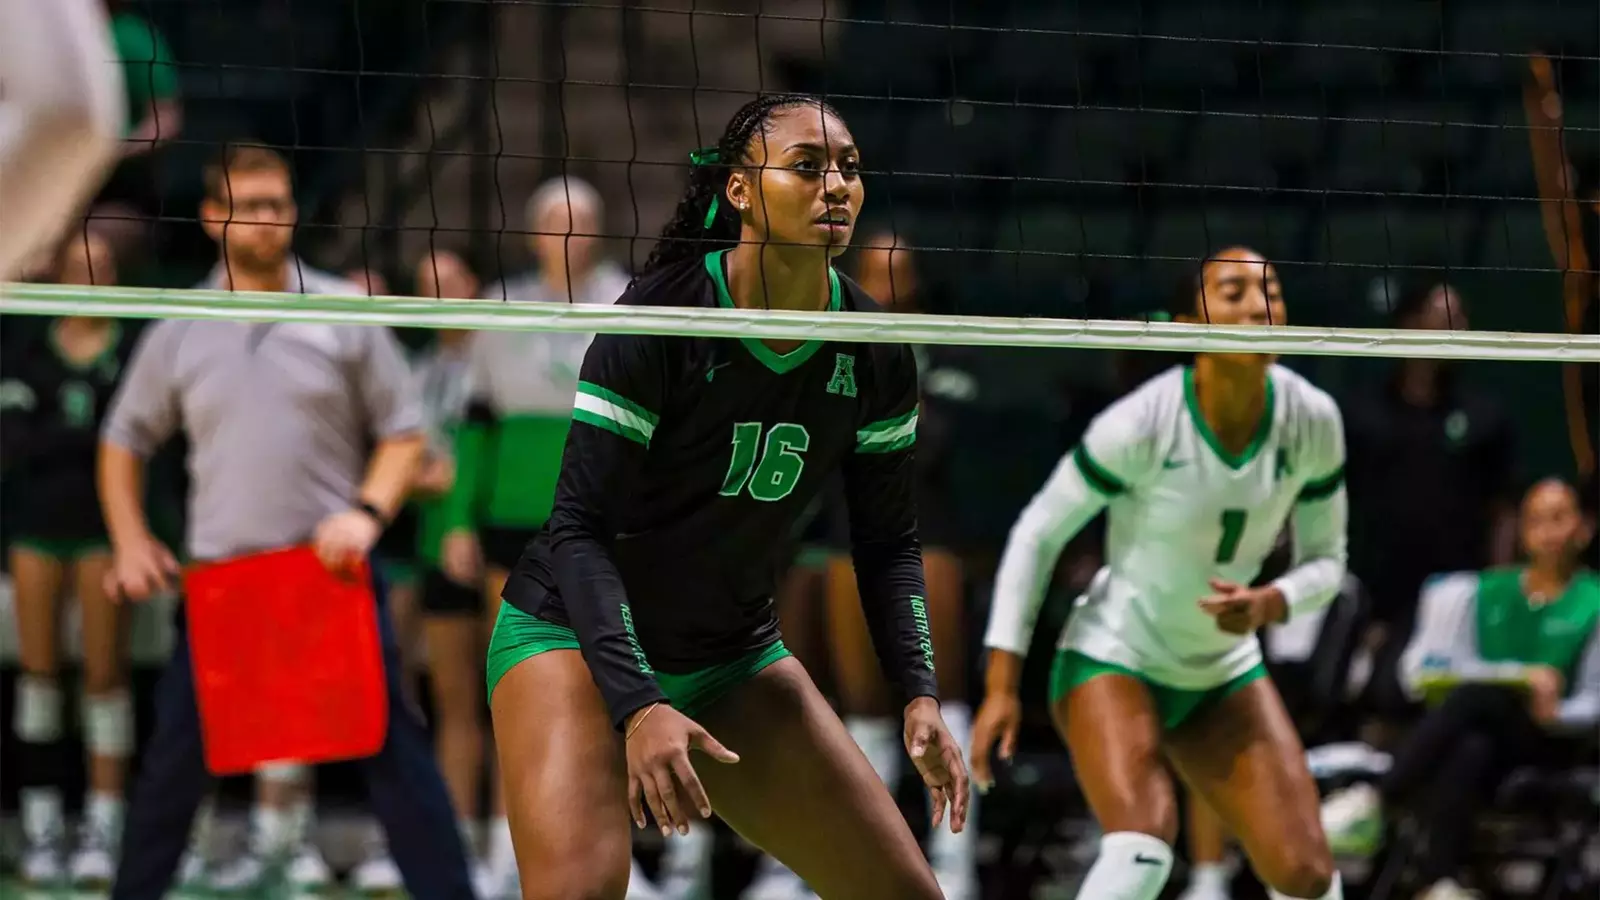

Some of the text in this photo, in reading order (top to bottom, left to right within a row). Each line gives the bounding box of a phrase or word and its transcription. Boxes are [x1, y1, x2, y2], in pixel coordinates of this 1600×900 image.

[826, 352, 858, 398] A
[717, 421, 810, 501] 16
[1213, 509, 1249, 564] 1
[620, 602, 640, 643] REEN
[909, 594, 931, 635] NORTH
